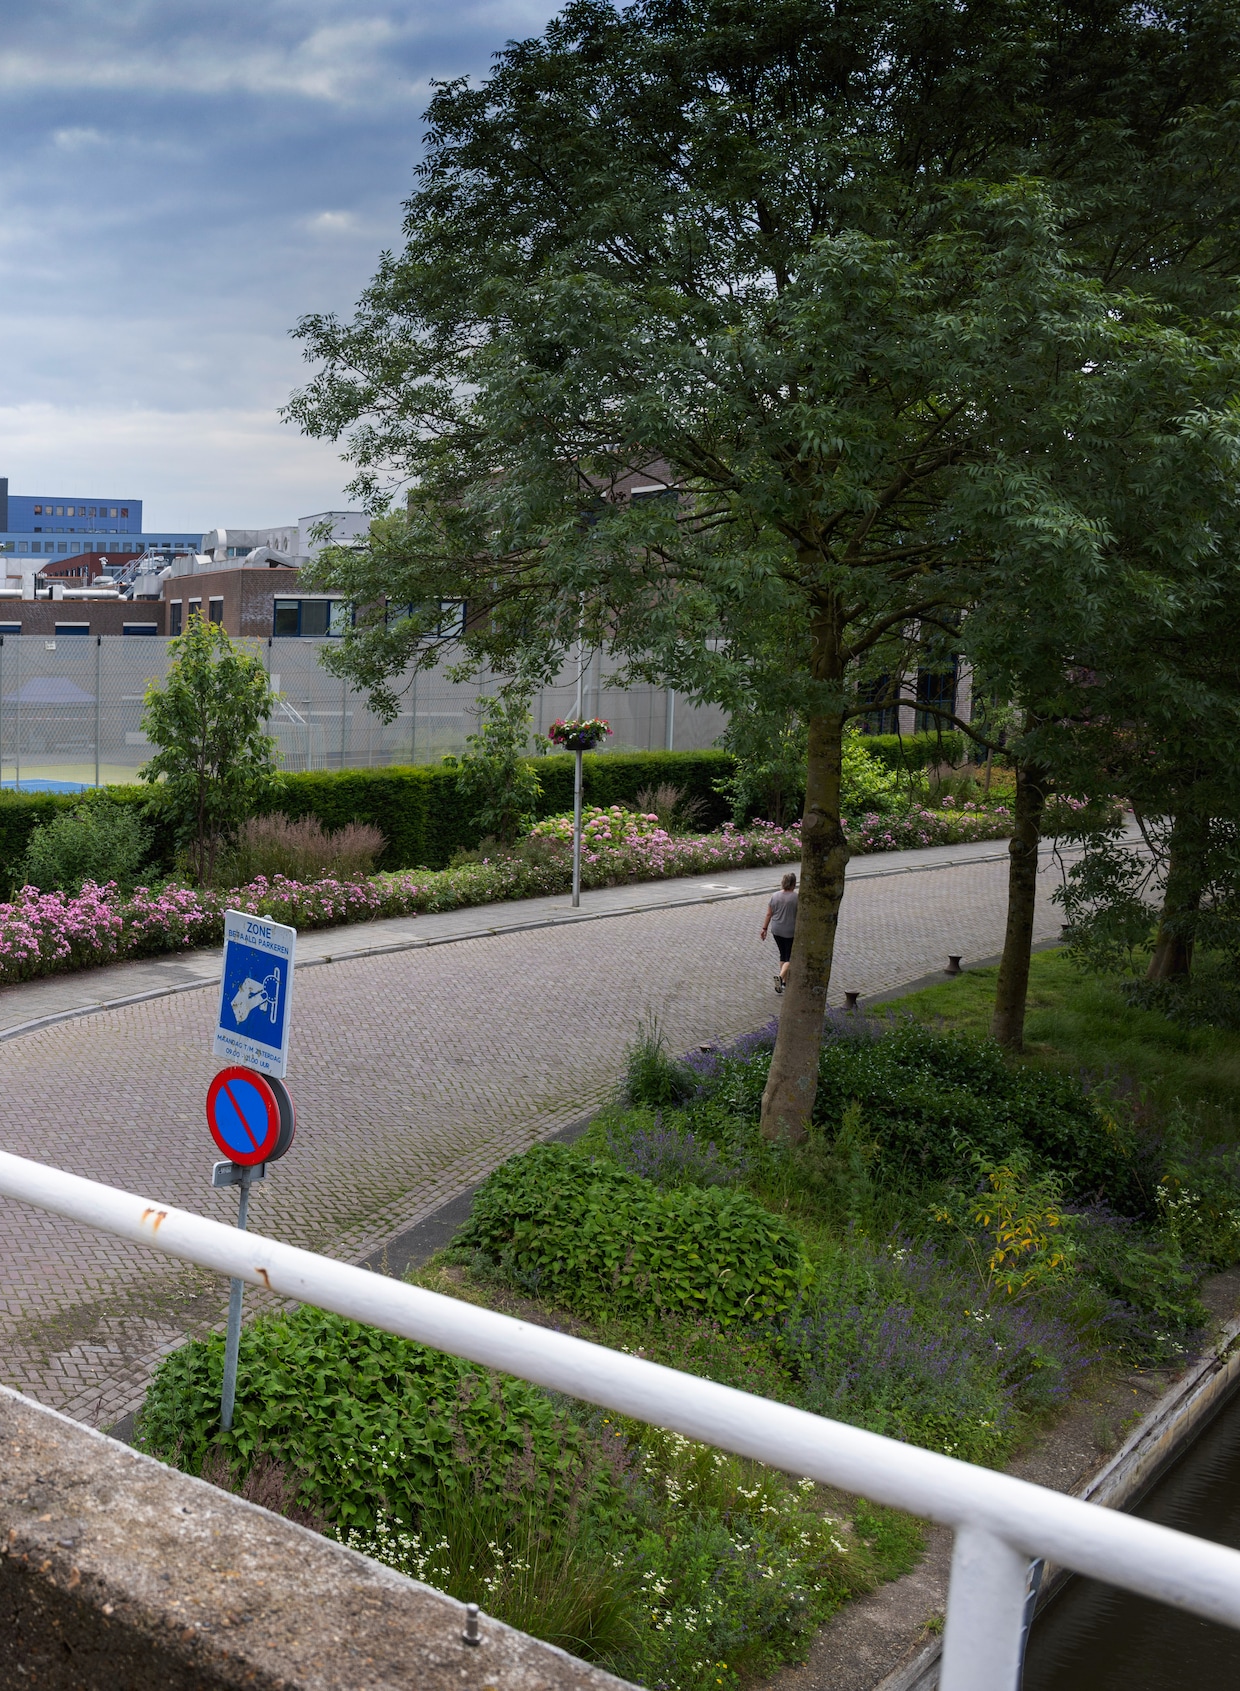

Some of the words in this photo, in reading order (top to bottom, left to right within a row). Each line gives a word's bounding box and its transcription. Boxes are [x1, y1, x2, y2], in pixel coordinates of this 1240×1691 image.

[246, 922, 272, 939] ZONE
[258, 938, 289, 955] PARKEREN
[217, 1034, 242, 1049] MAANDAG
[244, 1044, 254, 1053] T/M
[260, 1061, 270, 1069] UUR
